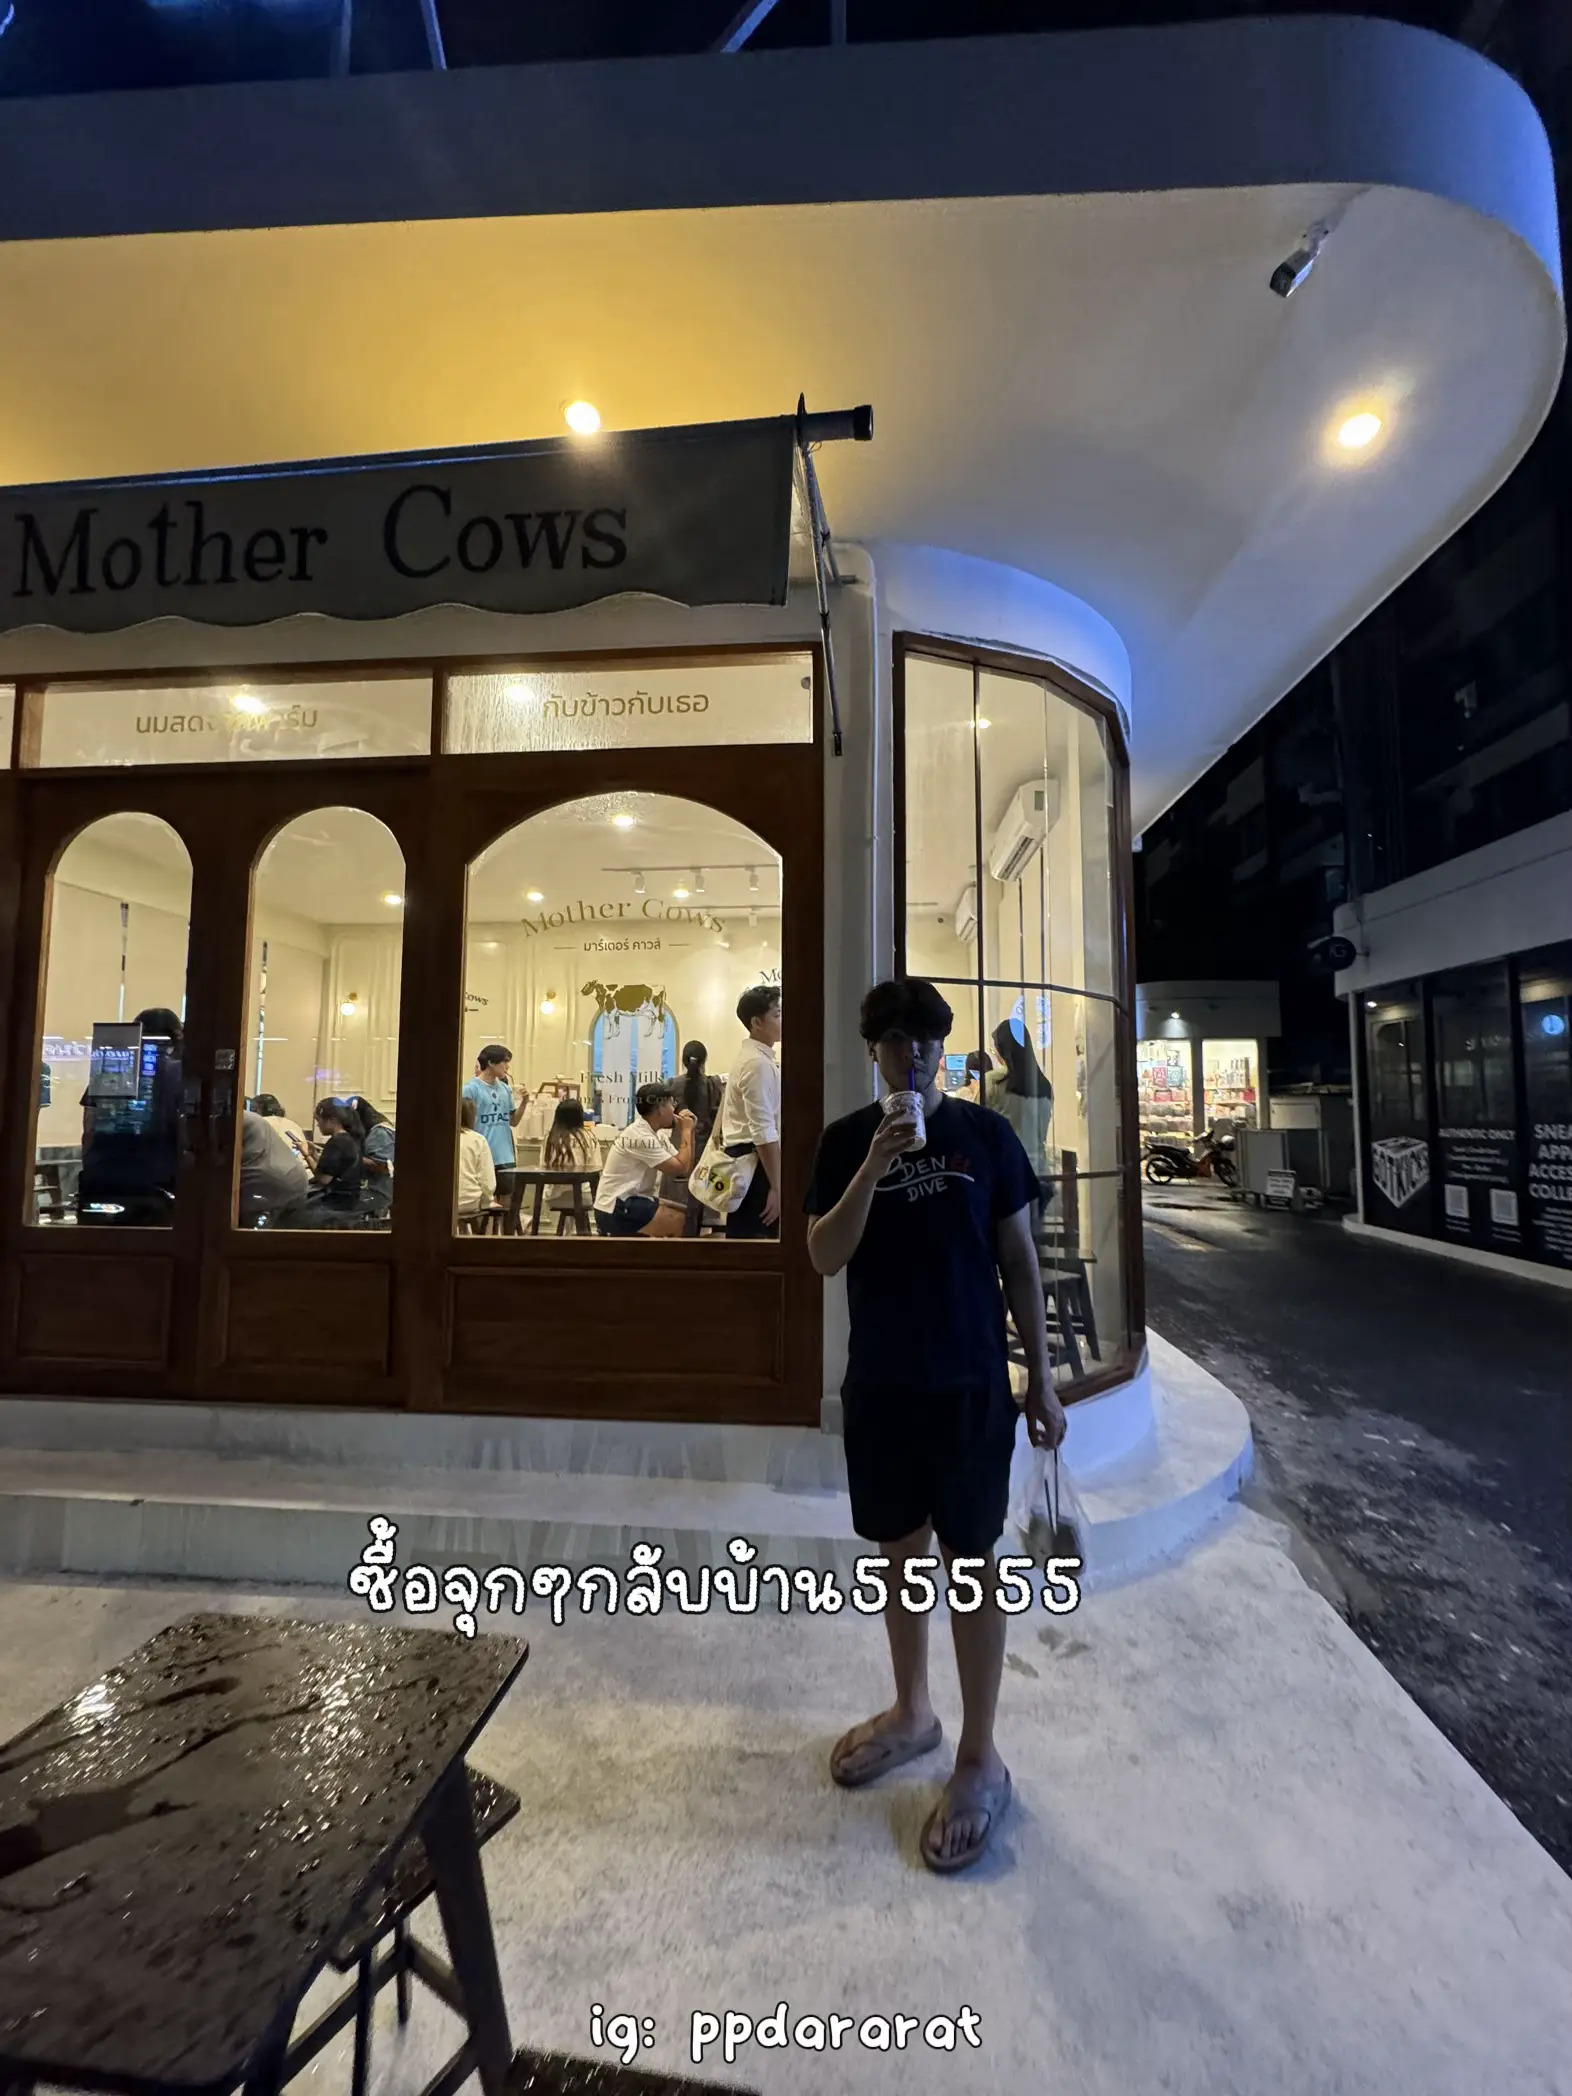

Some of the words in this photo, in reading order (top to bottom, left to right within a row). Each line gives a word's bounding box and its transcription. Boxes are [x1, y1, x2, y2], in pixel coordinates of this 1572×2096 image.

[11, 501, 329, 597] Mother
[382, 484, 628, 579] Cows
[543, 690, 710, 718] กับข้าวกับเธอ
[520, 899, 632, 938] Mother
[641, 898, 727, 934] Cows
[583, 938, 630, 952] มาร์เตอร์
[632, 937, 661, 950] คาวส์
[906, 1176, 948, 1202] DIVE
